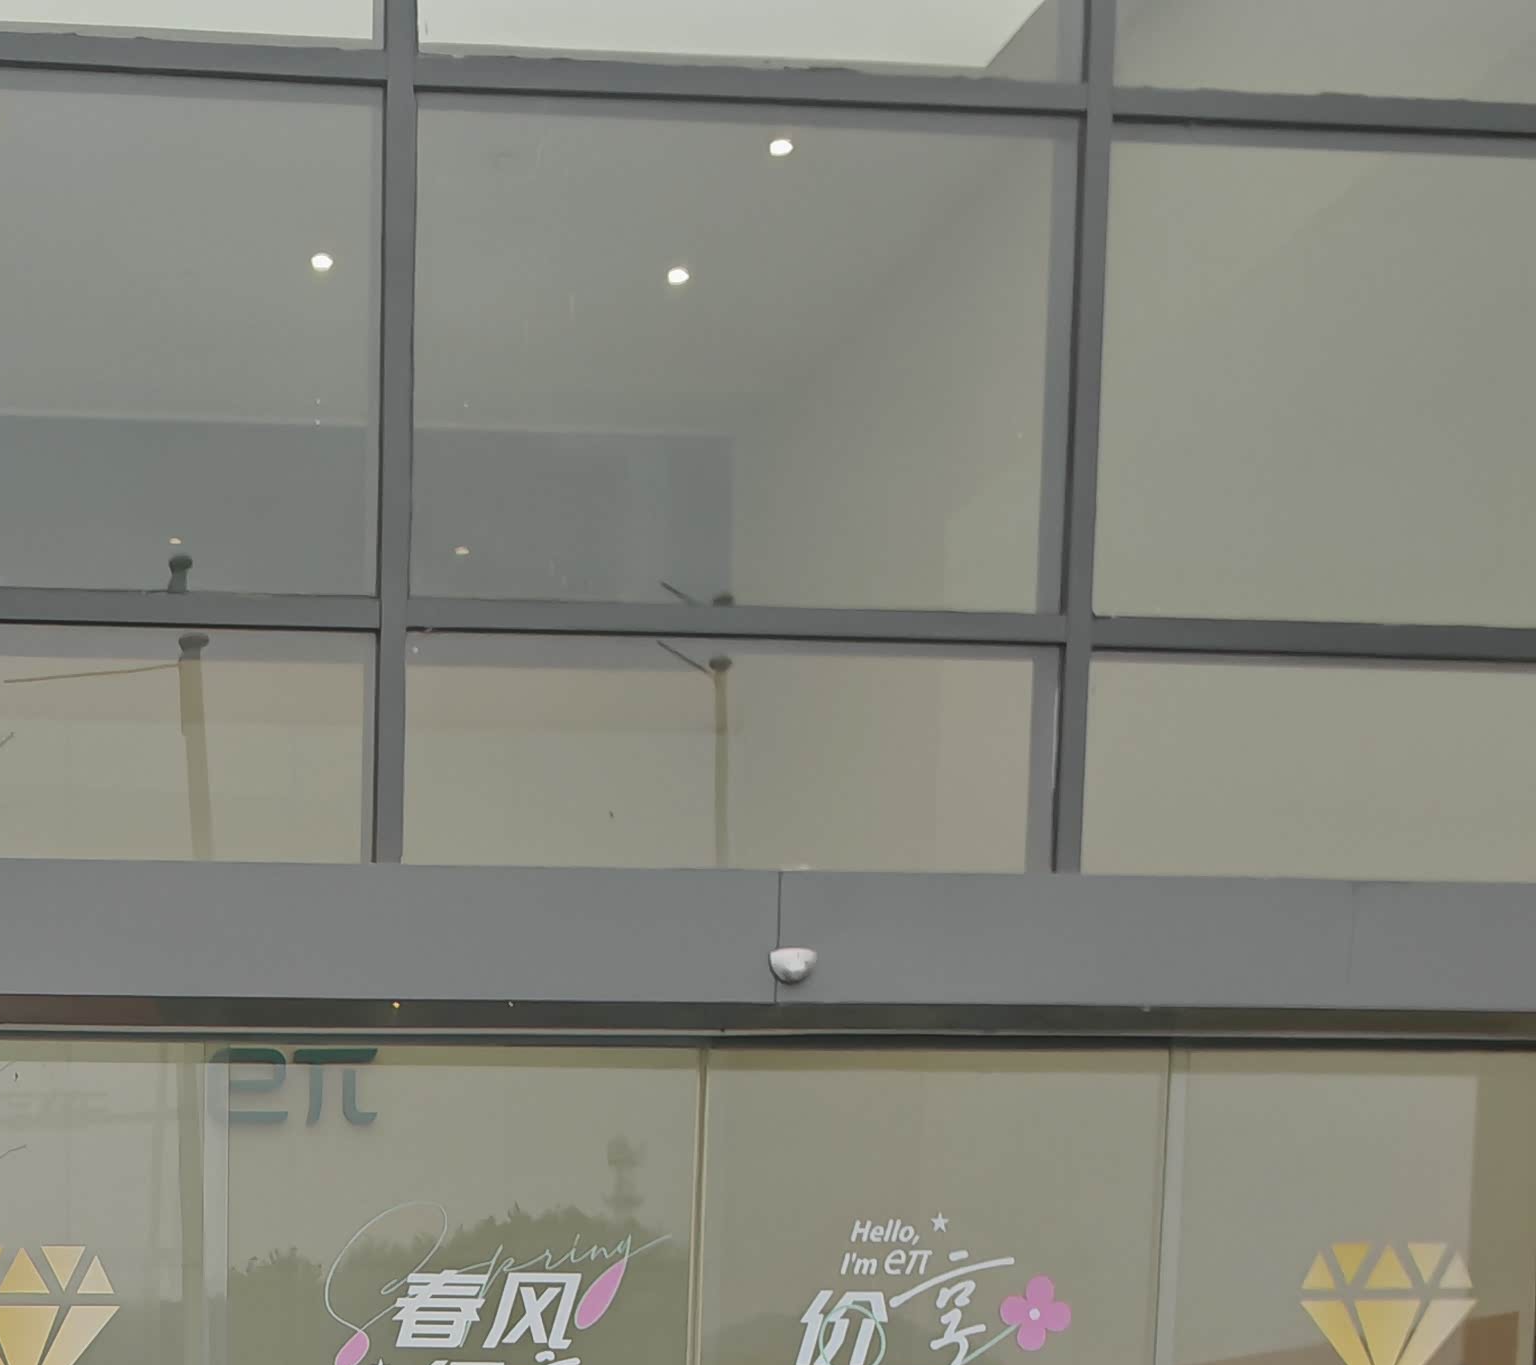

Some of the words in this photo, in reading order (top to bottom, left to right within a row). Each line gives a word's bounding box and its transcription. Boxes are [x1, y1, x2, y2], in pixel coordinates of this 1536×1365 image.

[851, 1219, 920, 1245] Hello,
[840, 1252, 878, 1275] I'm
[392, 1269, 582, 1350] 春风
